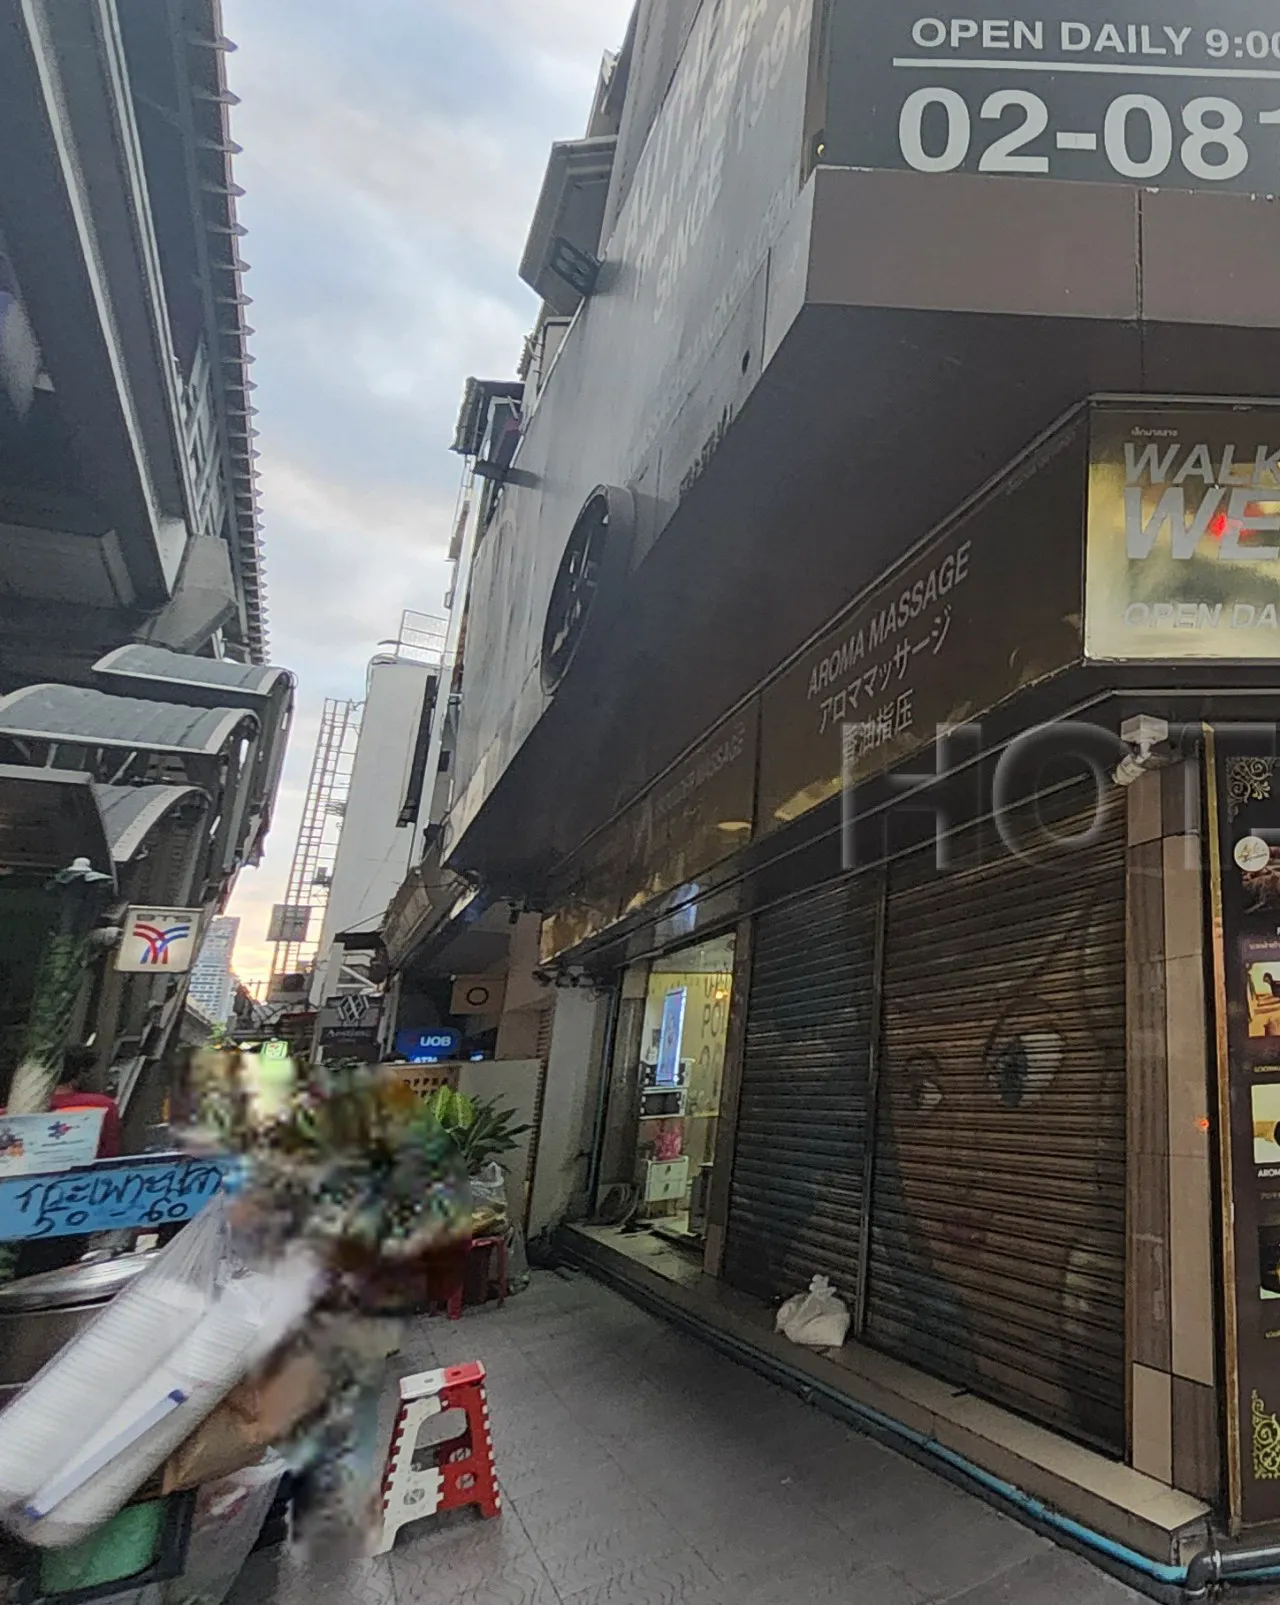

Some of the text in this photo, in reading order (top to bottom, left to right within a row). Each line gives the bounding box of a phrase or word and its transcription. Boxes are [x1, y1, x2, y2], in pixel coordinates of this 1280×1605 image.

[911, 17, 1043, 51] OPEN
[1060, 22, 1191, 57] DAILY
[807, 539, 972, 699] AROMA MASSAGE
[1123, 602, 1223, 631] OPEN
[819, 603, 953, 735] アロママッサージ
[419, 1036, 452, 1046] UOB
[26, 1208, 90, 1239] 50
